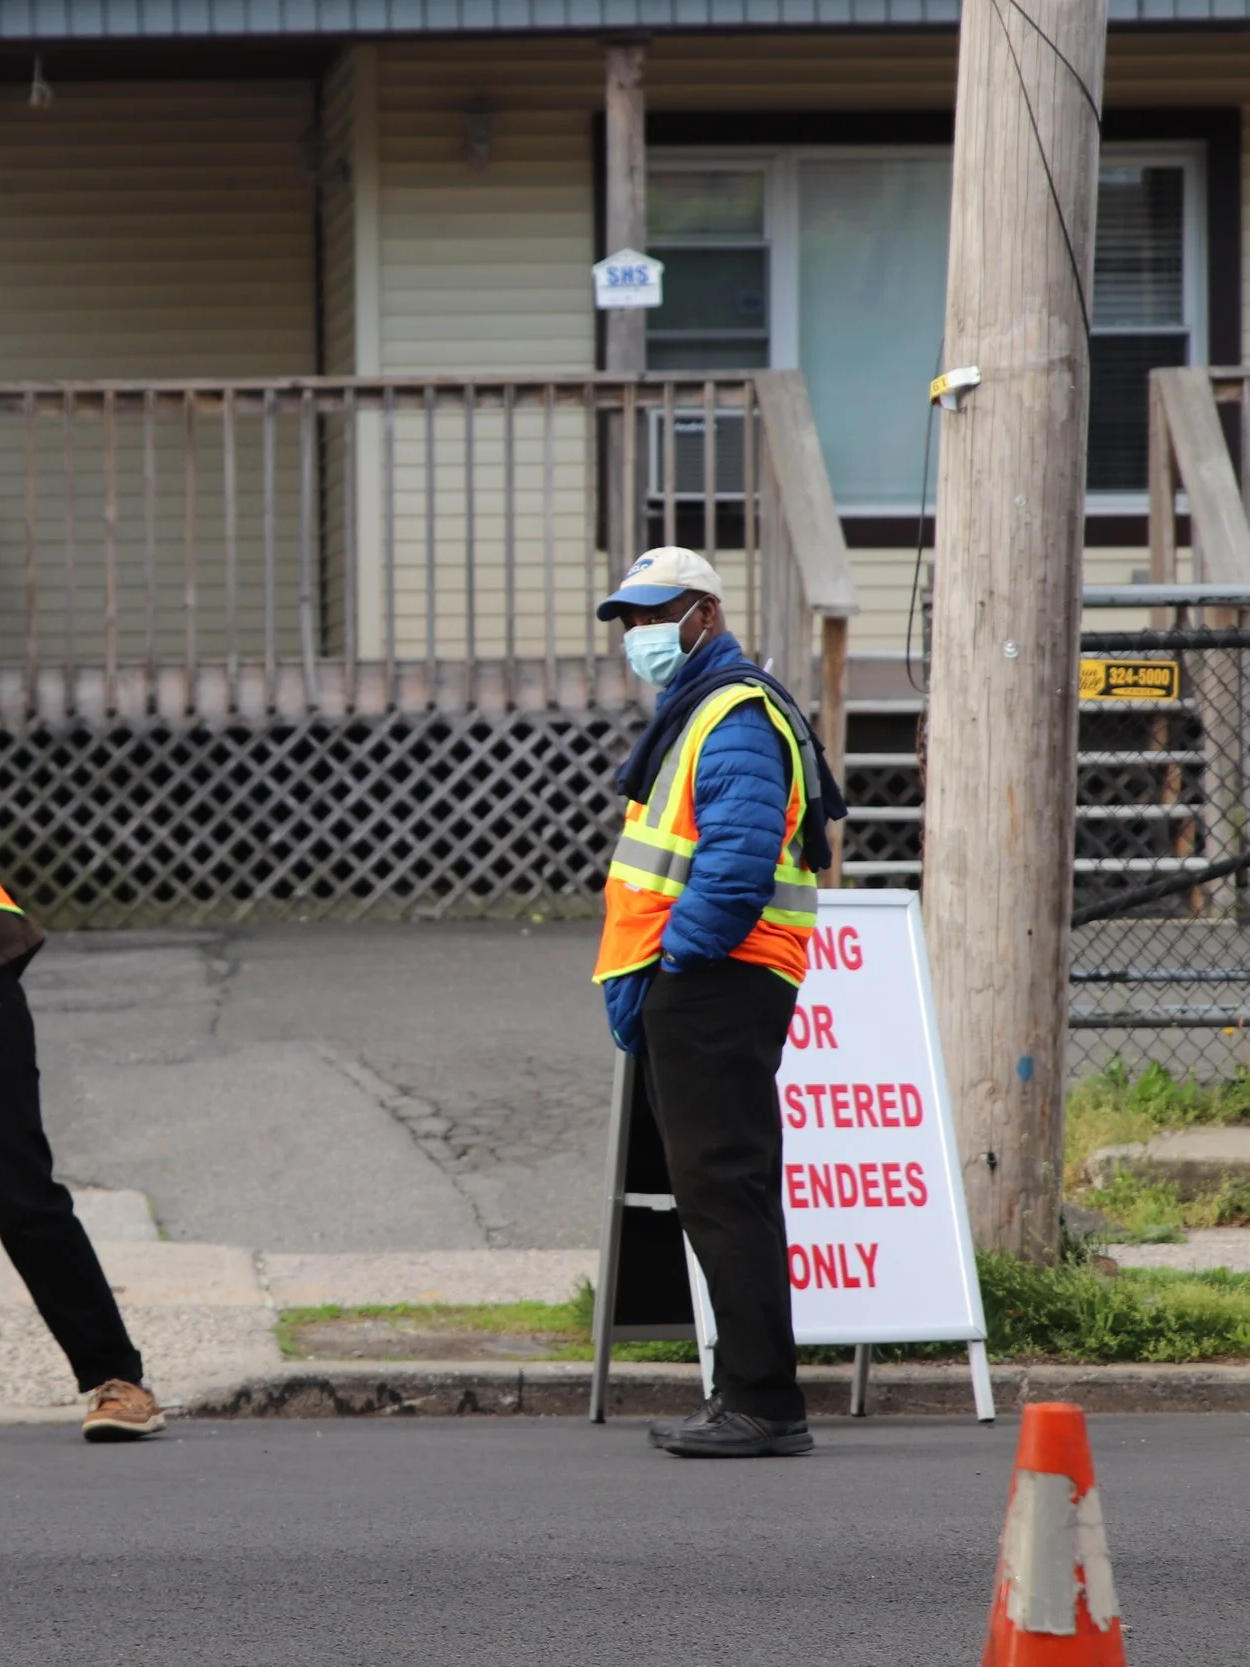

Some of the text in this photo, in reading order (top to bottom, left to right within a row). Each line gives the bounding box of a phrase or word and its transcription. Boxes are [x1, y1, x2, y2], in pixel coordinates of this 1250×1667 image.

[1109, 667, 1170, 685] 324-5000
[788, 1004, 838, 1050] OR
[781, 1083, 924, 1129] STERED
[785, 1161, 928, 1209] ENDEES
[788, 1243, 879, 1290] ONLY
